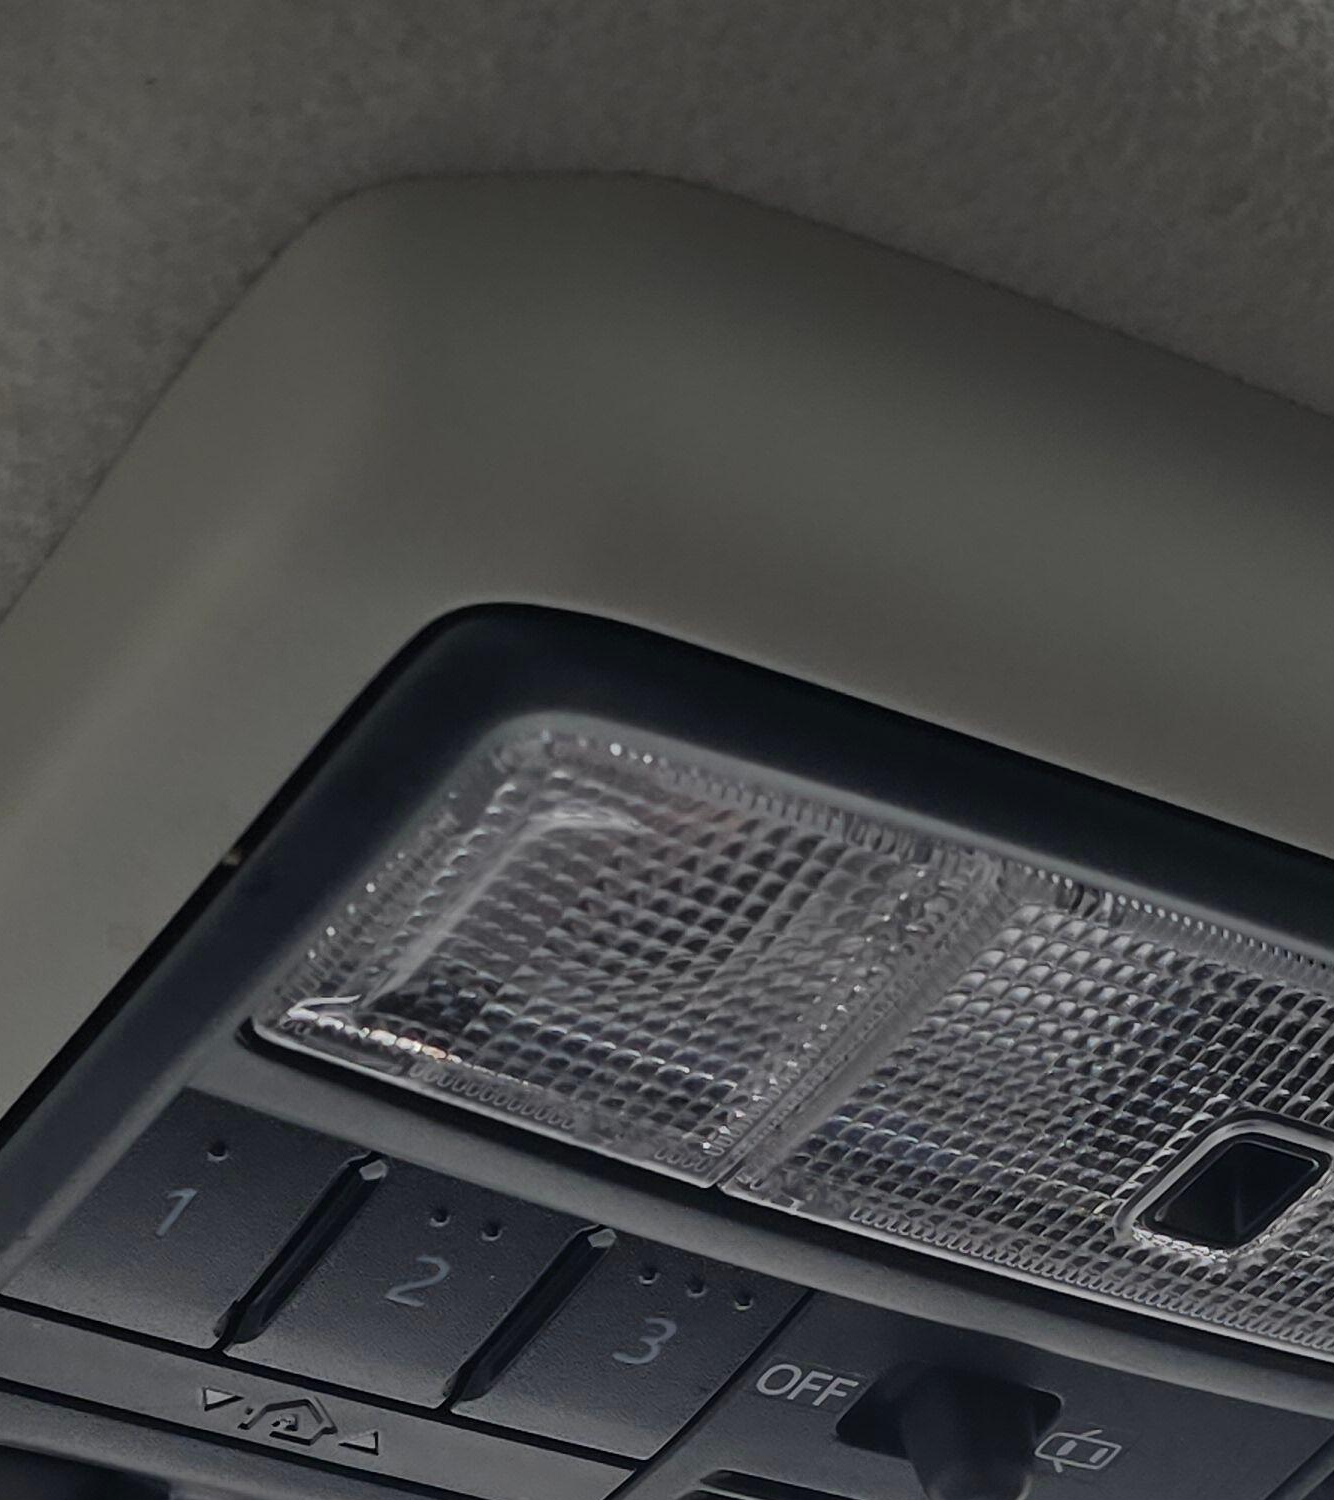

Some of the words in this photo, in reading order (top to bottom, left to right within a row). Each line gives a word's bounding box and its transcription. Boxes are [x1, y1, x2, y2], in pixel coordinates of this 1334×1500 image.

[155, 1187, 198, 1238] 1
[385, 1256, 451, 1308] 2
[612, 1316, 678, 1366] 3
[755, 1363, 860, 1407] OFF
